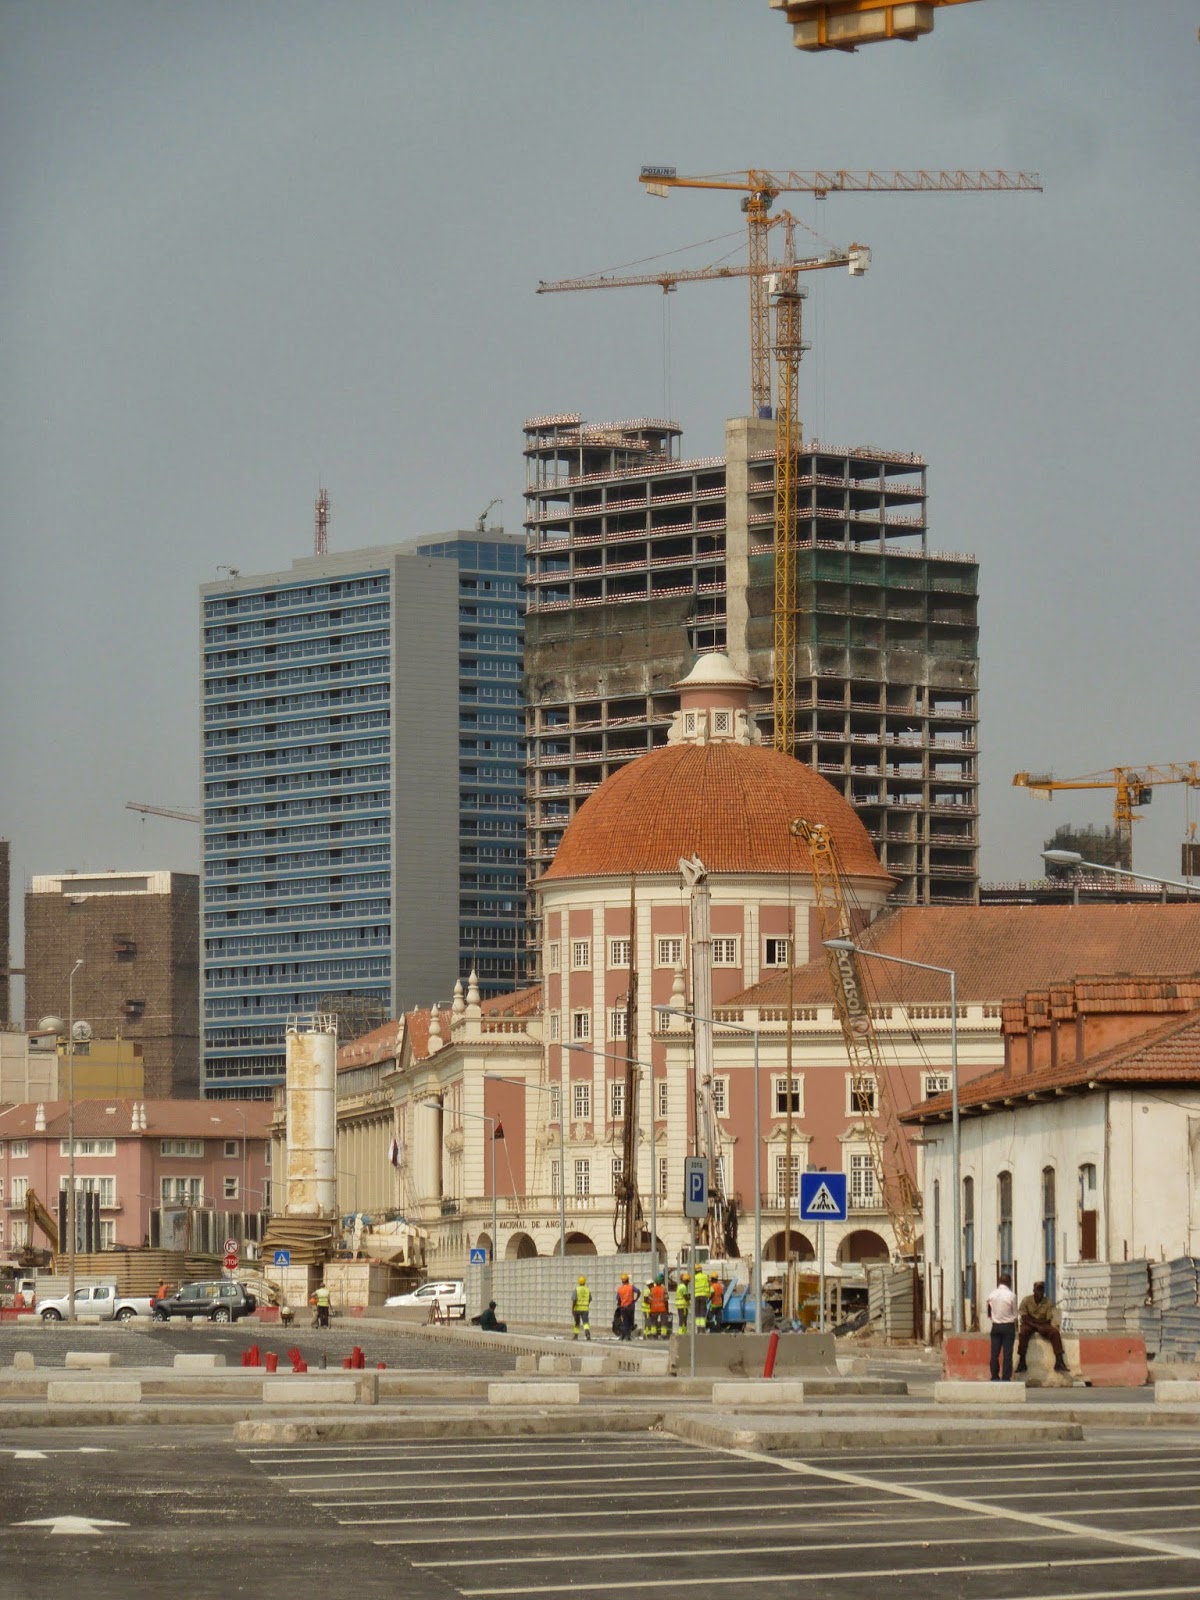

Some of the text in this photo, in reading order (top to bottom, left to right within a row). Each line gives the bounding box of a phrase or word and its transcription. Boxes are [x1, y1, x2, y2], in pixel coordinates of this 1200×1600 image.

[836, 936, 862, 1015] ecnasol
[692, 1174, 702, 1201] P
[499, 1221, 527, 1229] NACIONAL
[531, 1220, 540, 1229] DE
[224, 1258, 239, 1266] STOP
